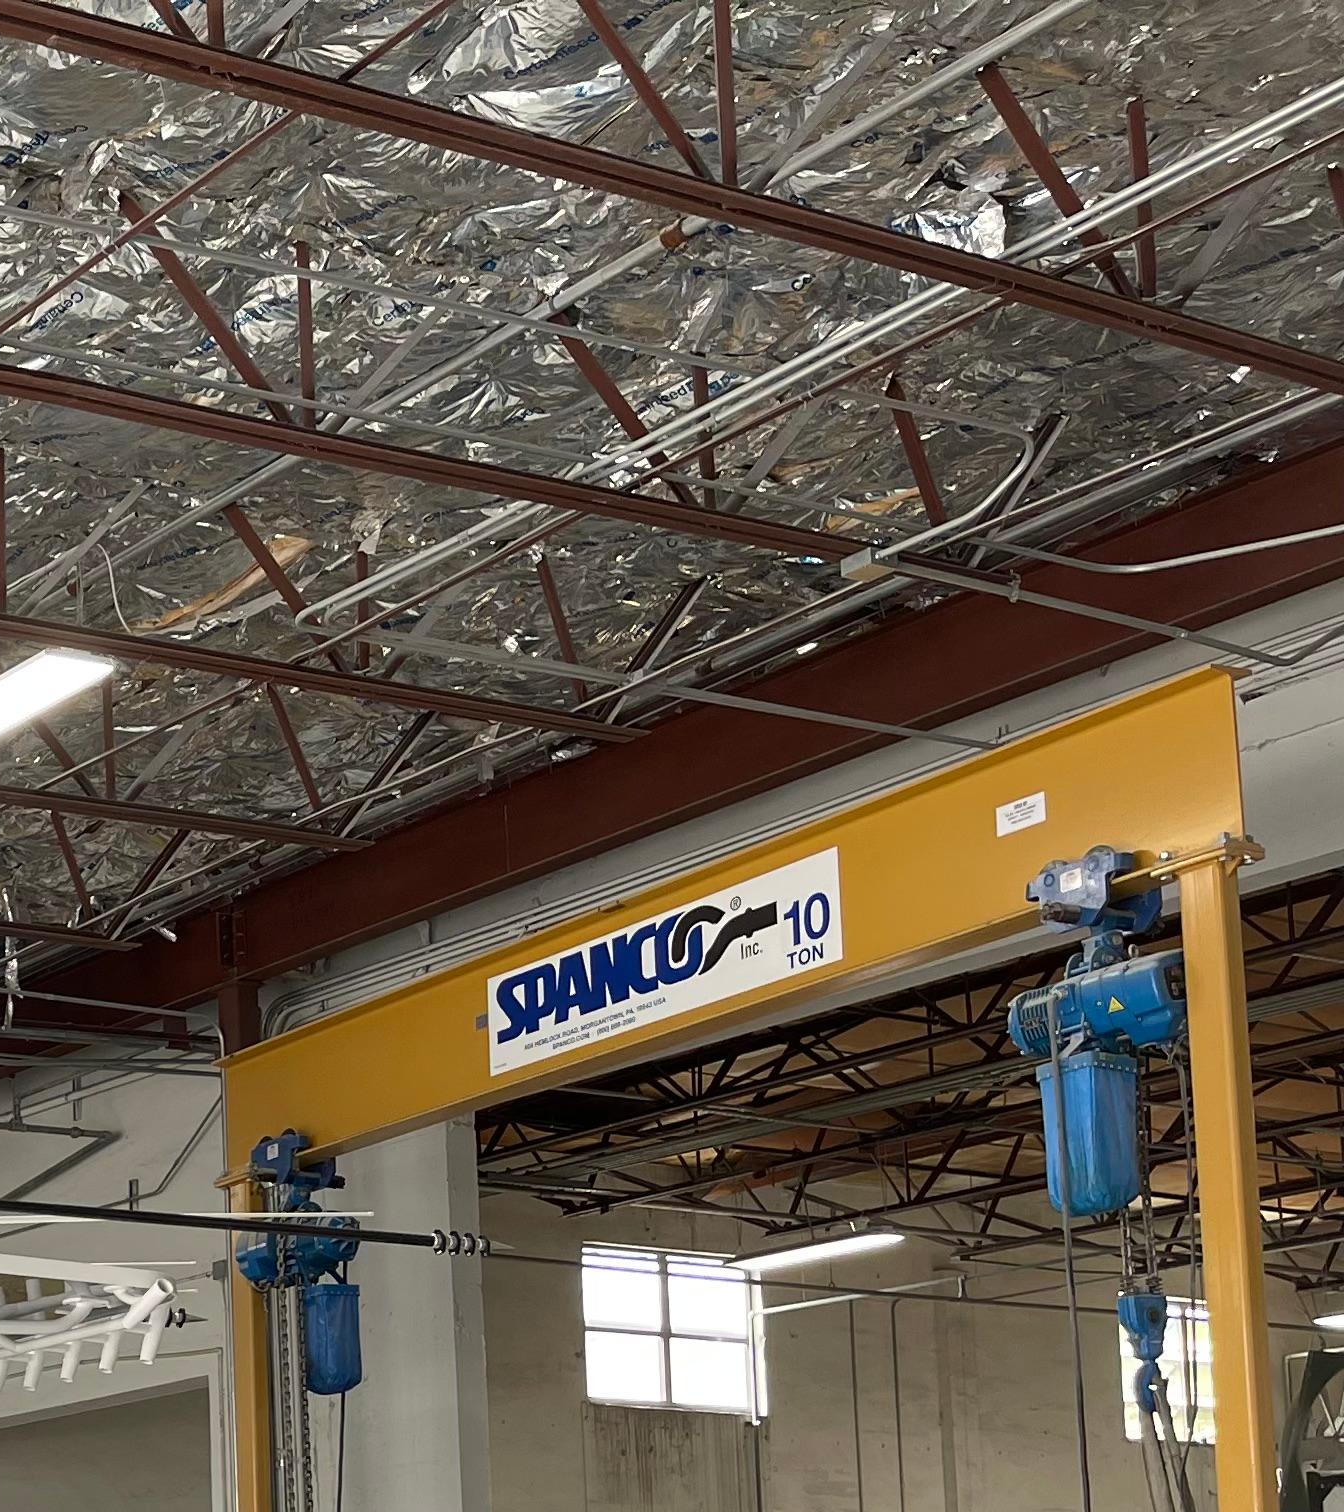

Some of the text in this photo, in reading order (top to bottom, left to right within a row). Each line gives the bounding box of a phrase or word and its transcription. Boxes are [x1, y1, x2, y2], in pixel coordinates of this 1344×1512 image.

[784, 892, 830, 947] 10
[497, 904, 764, 1045] SPANCO Inc.
[787, 941, 825, 970] TON
